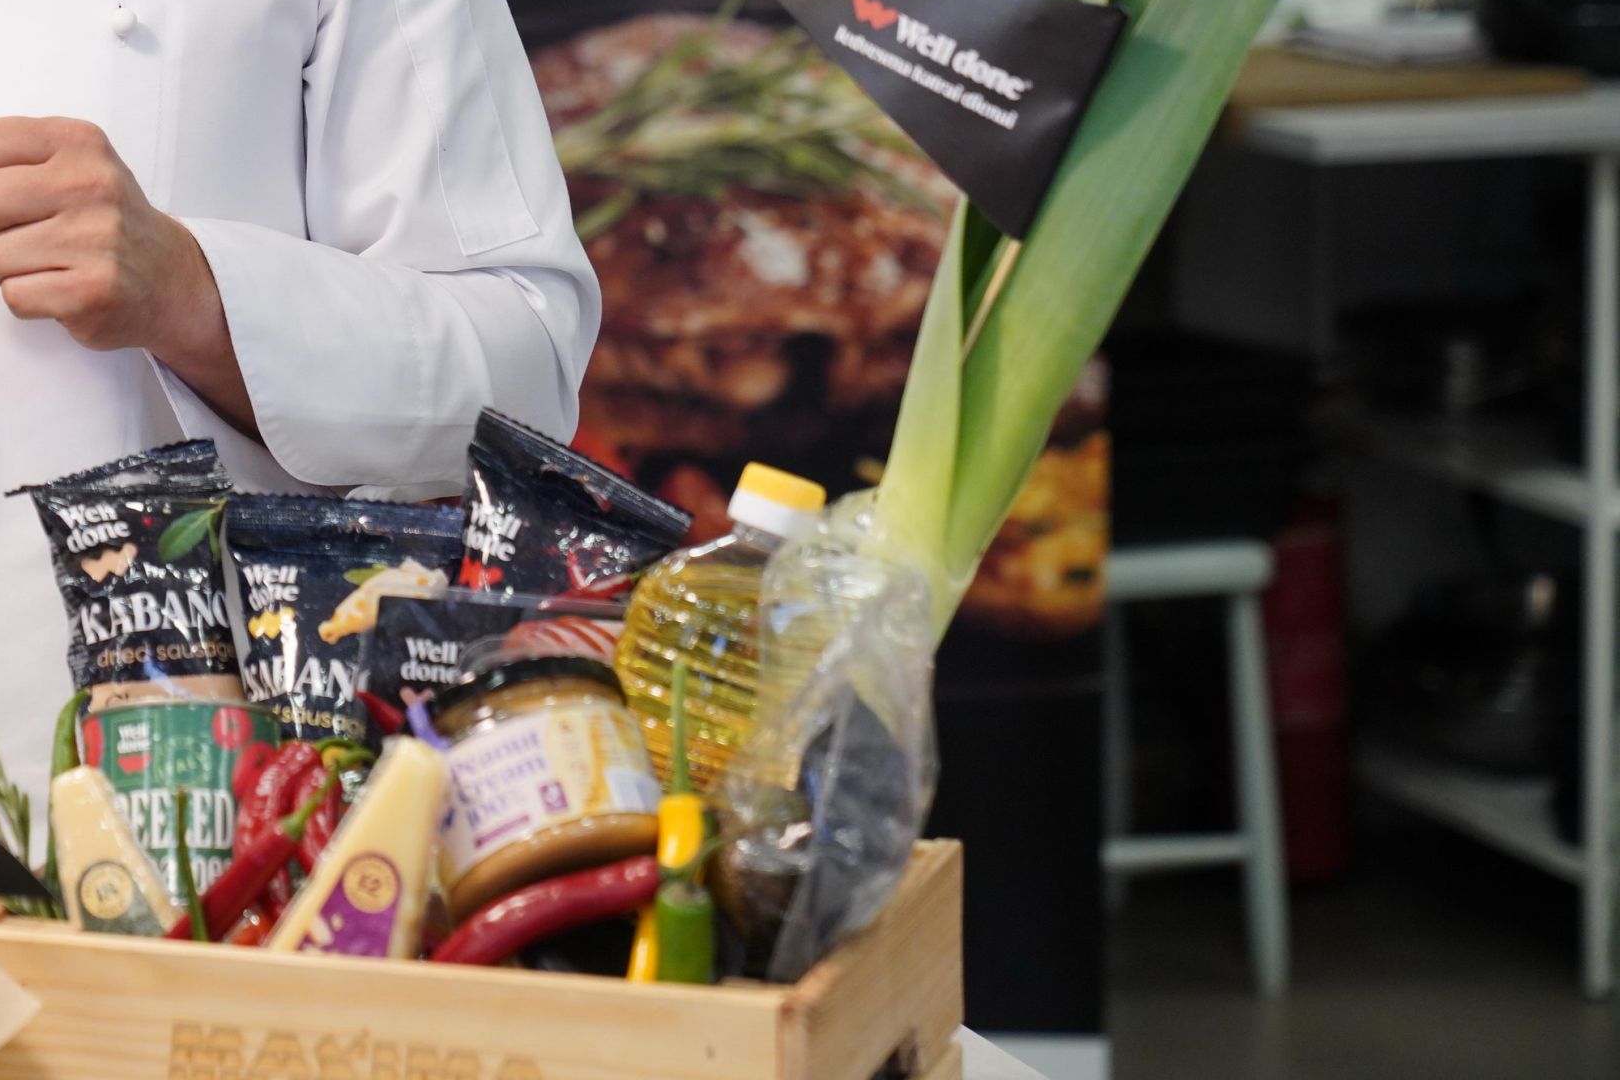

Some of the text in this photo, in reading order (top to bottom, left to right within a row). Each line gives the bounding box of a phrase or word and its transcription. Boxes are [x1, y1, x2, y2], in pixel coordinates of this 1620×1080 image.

[895, 12, 1026, 102] Well done
[66, 520, 130, 553] done
[242, 565, 299, 587] Well
[405, 636, 459, 665] Well
[114, 787, 234, 851] PEEED
